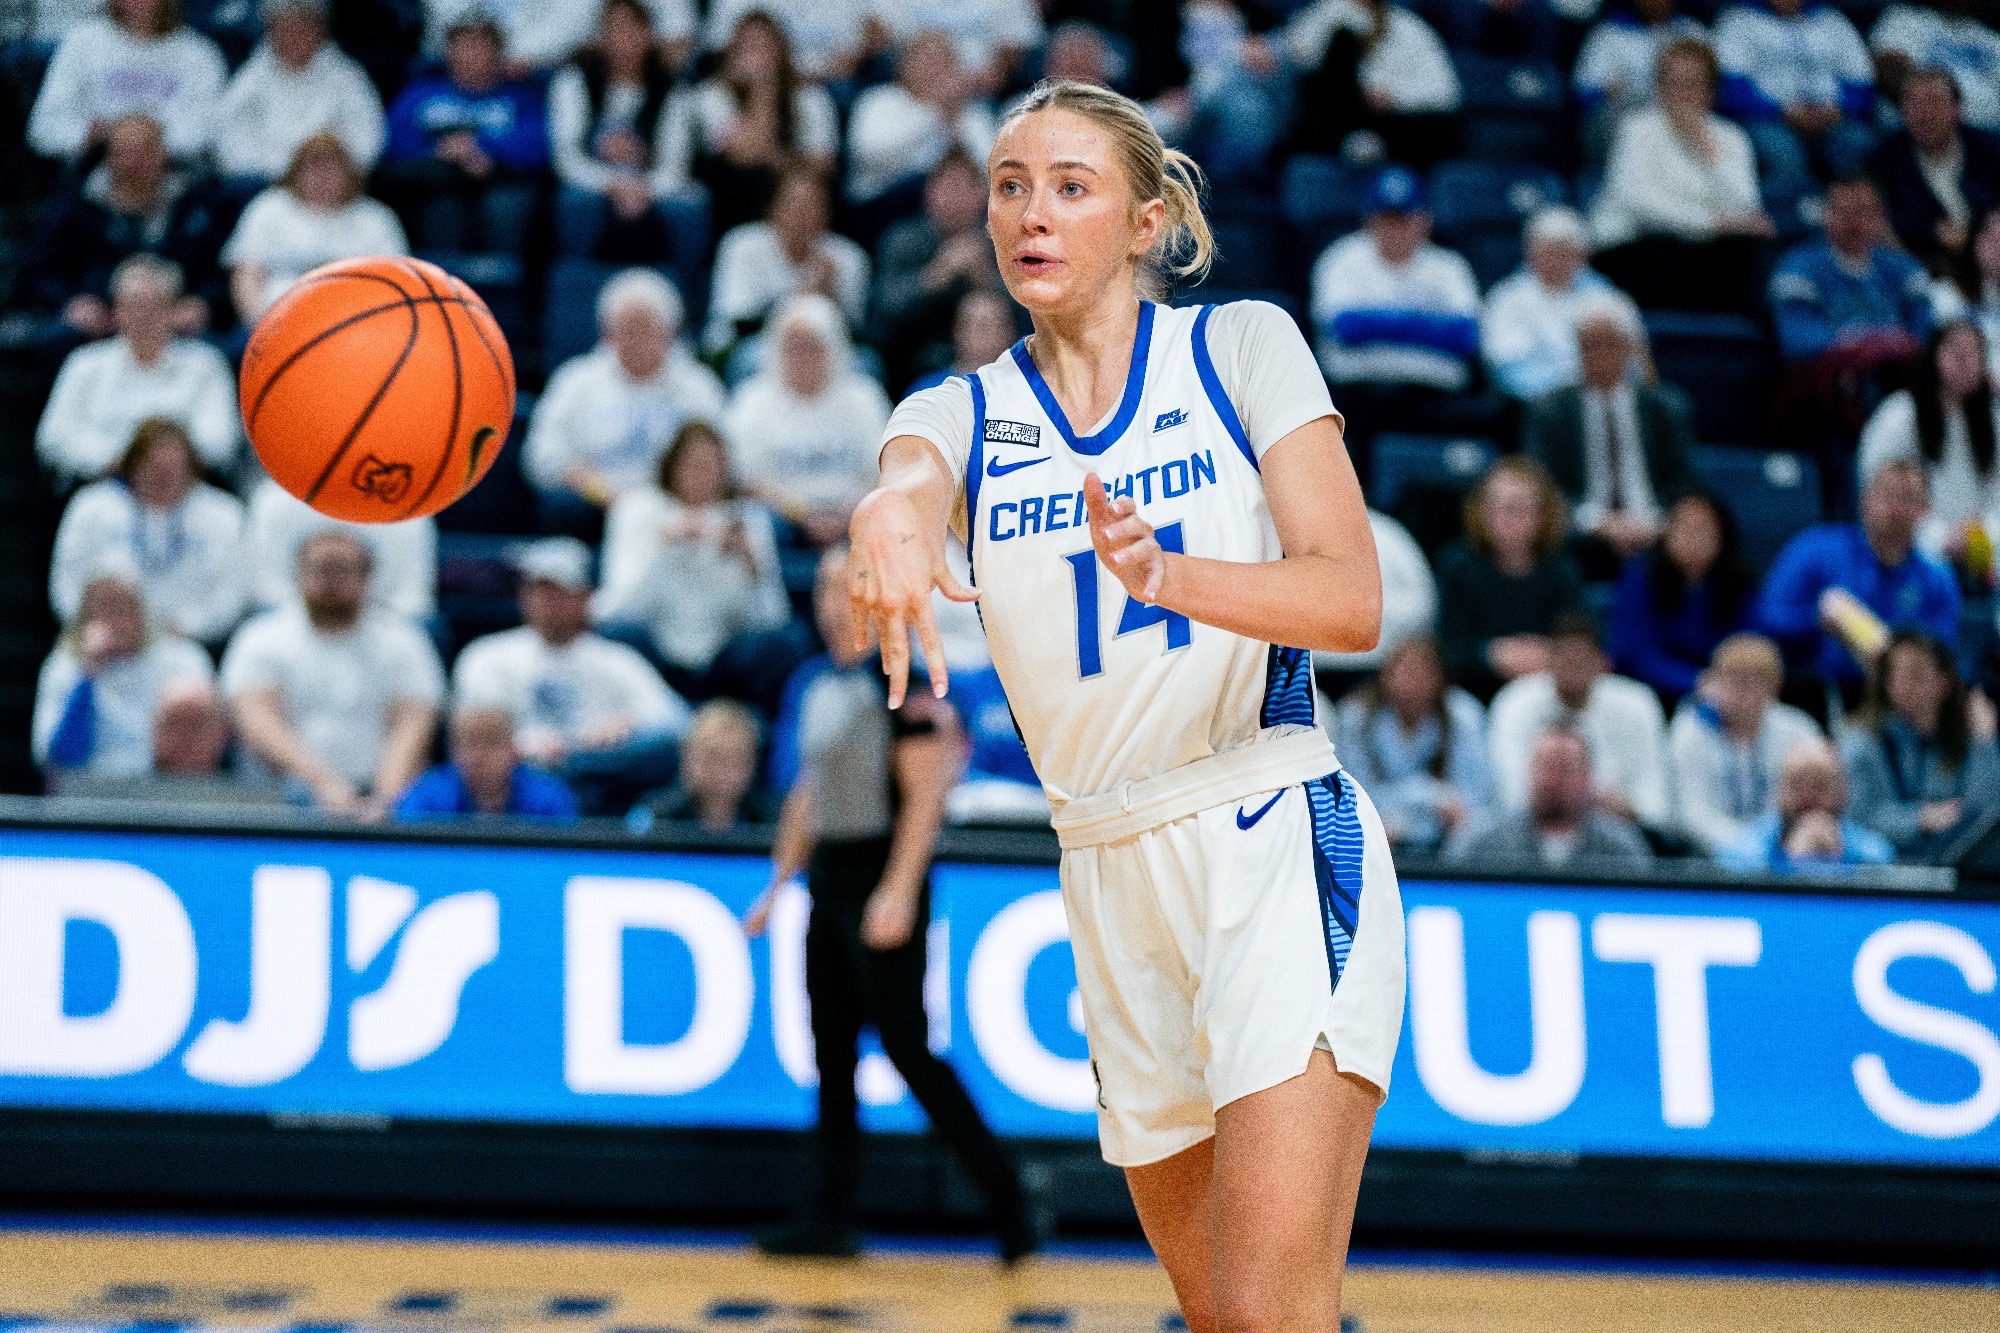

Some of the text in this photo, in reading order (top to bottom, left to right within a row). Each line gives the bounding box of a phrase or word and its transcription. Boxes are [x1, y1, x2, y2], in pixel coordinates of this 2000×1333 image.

[985, 430, 1039, 445] CHANGE
[1154, 411, 1189, 429] EAST
[989, 448, 1217, 542] CREIHTON
[1059, 518, 1195, 682] 14
